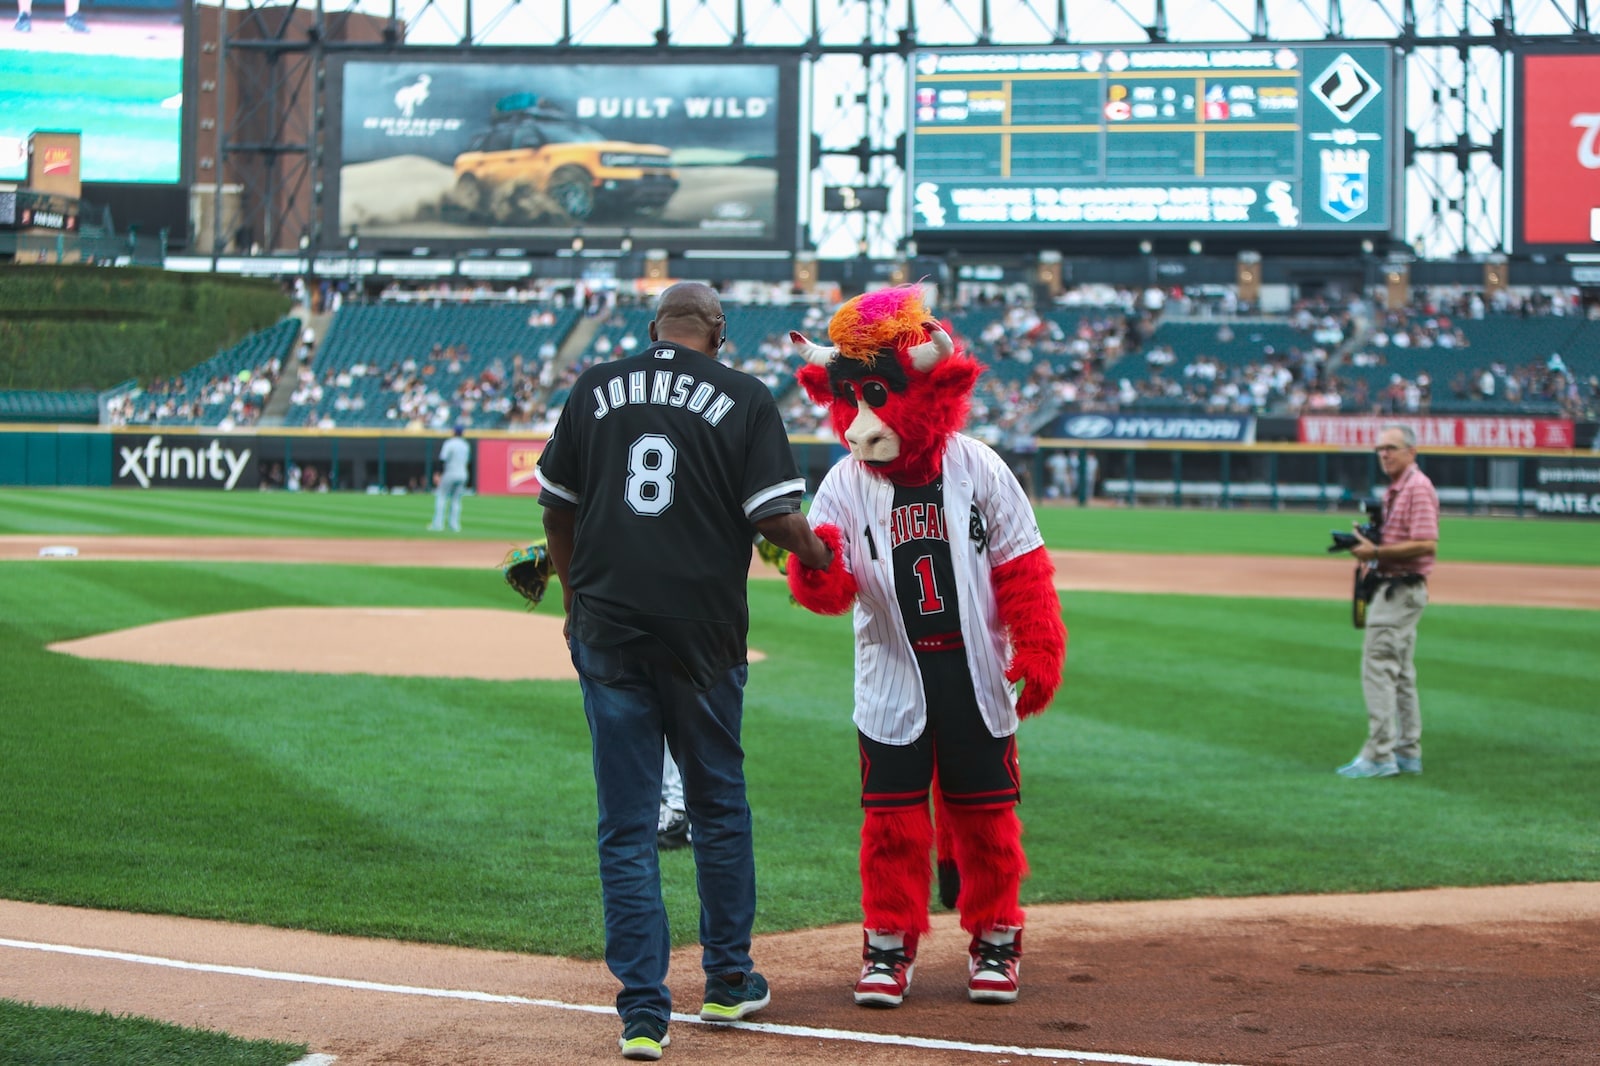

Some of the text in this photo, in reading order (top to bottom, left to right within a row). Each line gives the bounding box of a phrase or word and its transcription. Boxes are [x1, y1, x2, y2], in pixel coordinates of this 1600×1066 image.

[577, 97, 767, 118] BUILT WILD
[593, 370, 735, 427] JOHNSON
[1114, 418, 1241, 440] HYUNDAI
[119, 435, 251, 491] xfinity
[624, 433, 678, 517] 8
[864, 524, 878, 560] 1
[913, 555, 945, 615] 1
